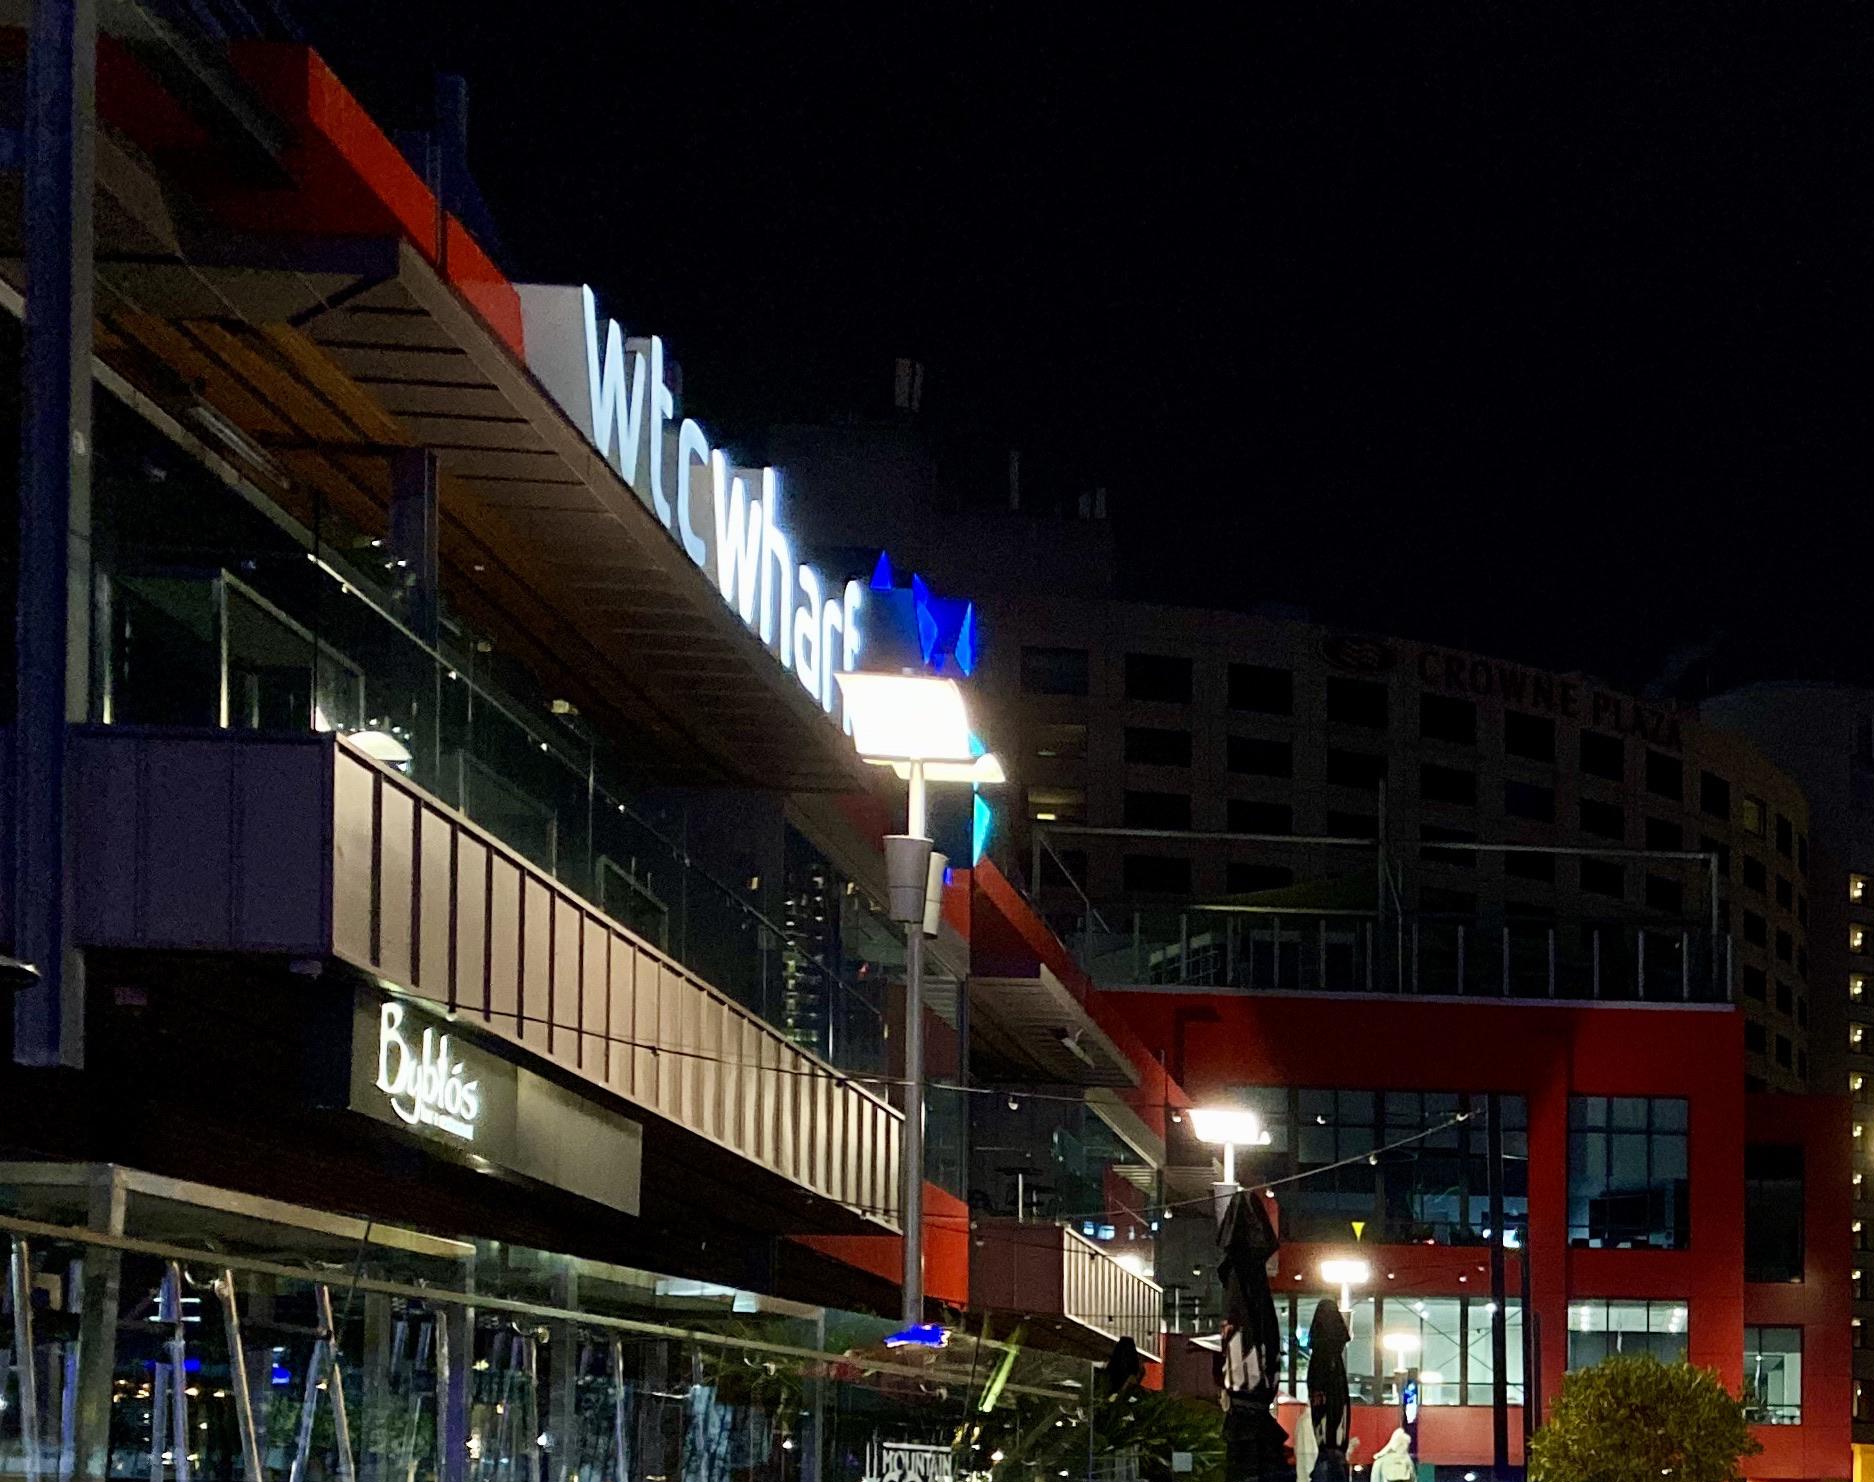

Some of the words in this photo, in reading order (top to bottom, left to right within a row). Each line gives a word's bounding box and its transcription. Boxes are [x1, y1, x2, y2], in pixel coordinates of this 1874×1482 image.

[1419, 650, 1581, 718] CROWNE
[1593, 691, 1683, 750] PLAZA
[882, 1449, 952, 1476] MOUNTAIN
